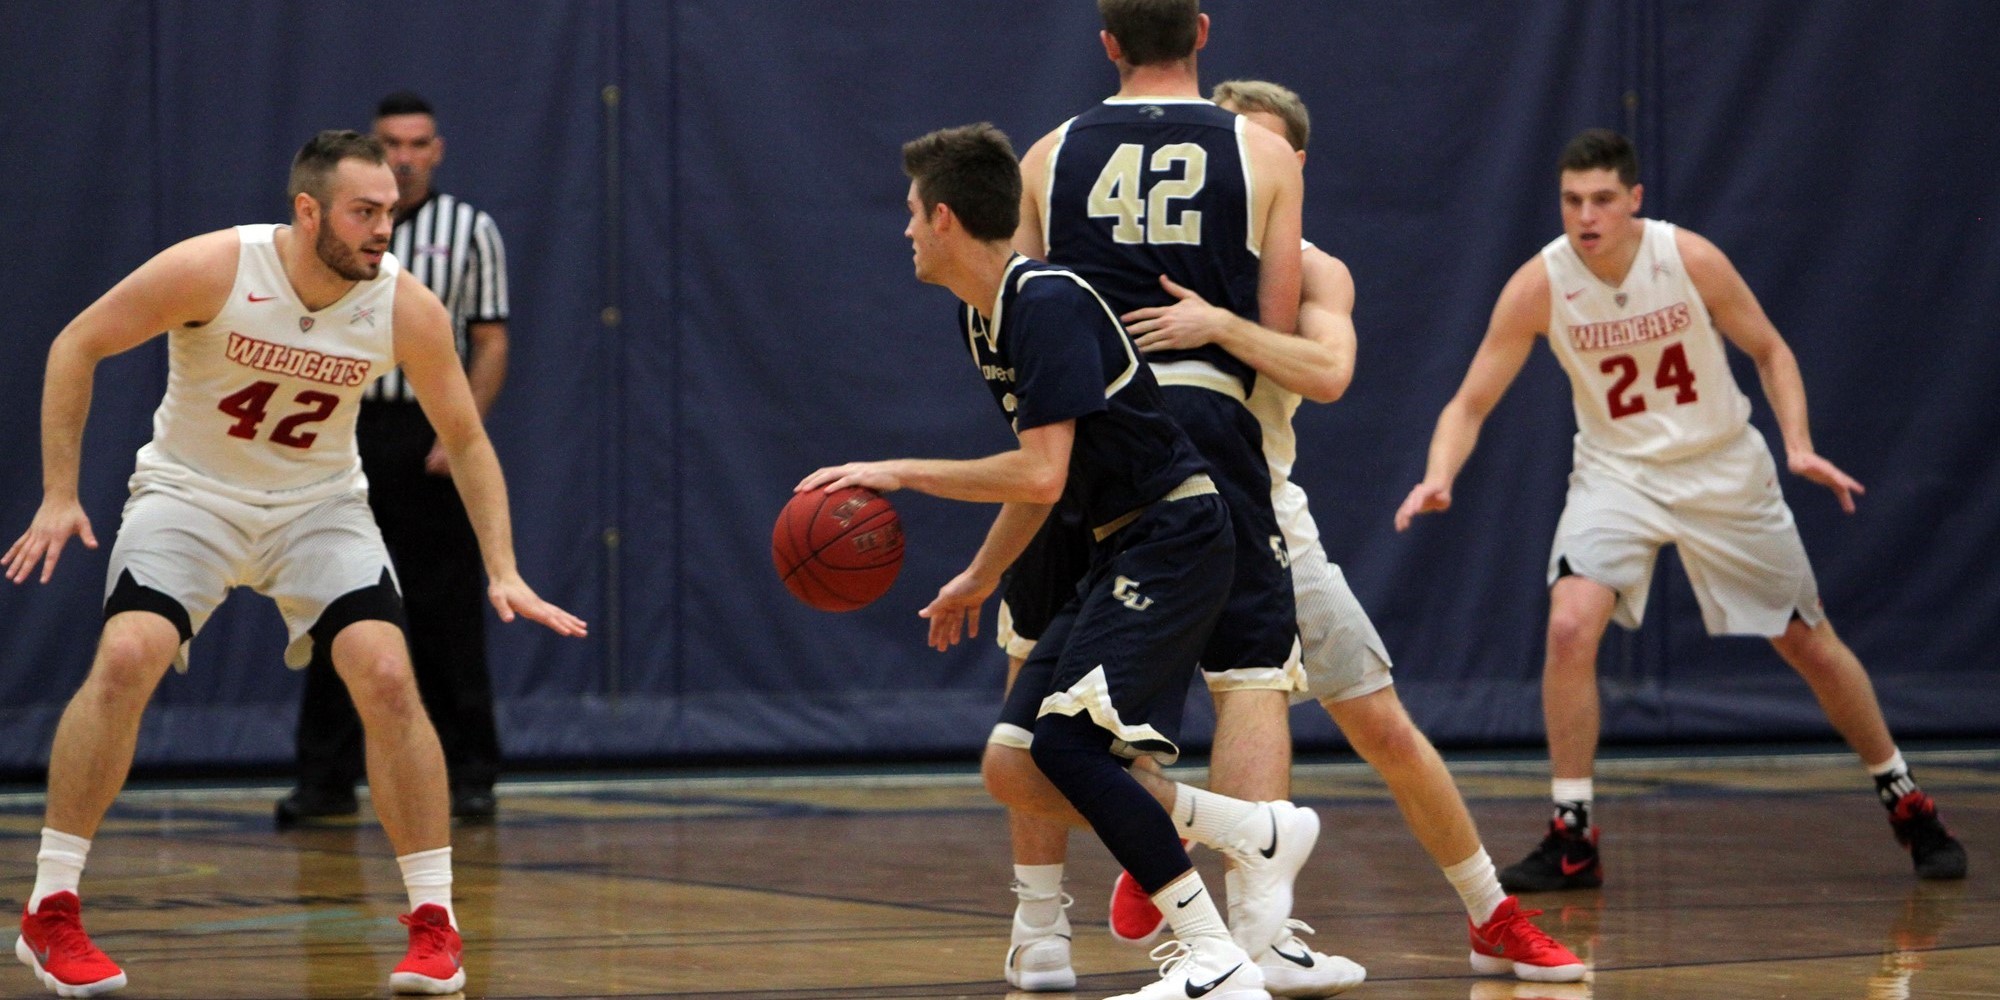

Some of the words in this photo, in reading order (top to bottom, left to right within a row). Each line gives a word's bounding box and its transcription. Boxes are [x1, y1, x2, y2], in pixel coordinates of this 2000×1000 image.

[1087, 142, 1208, 246] 42
[225, 332, 371, 387] WILDCATS
[1567, 302, 1692, 353] WILDCATS
[217, 380, 340, 449] 42
[1598, 341, 1699, 420] 24
